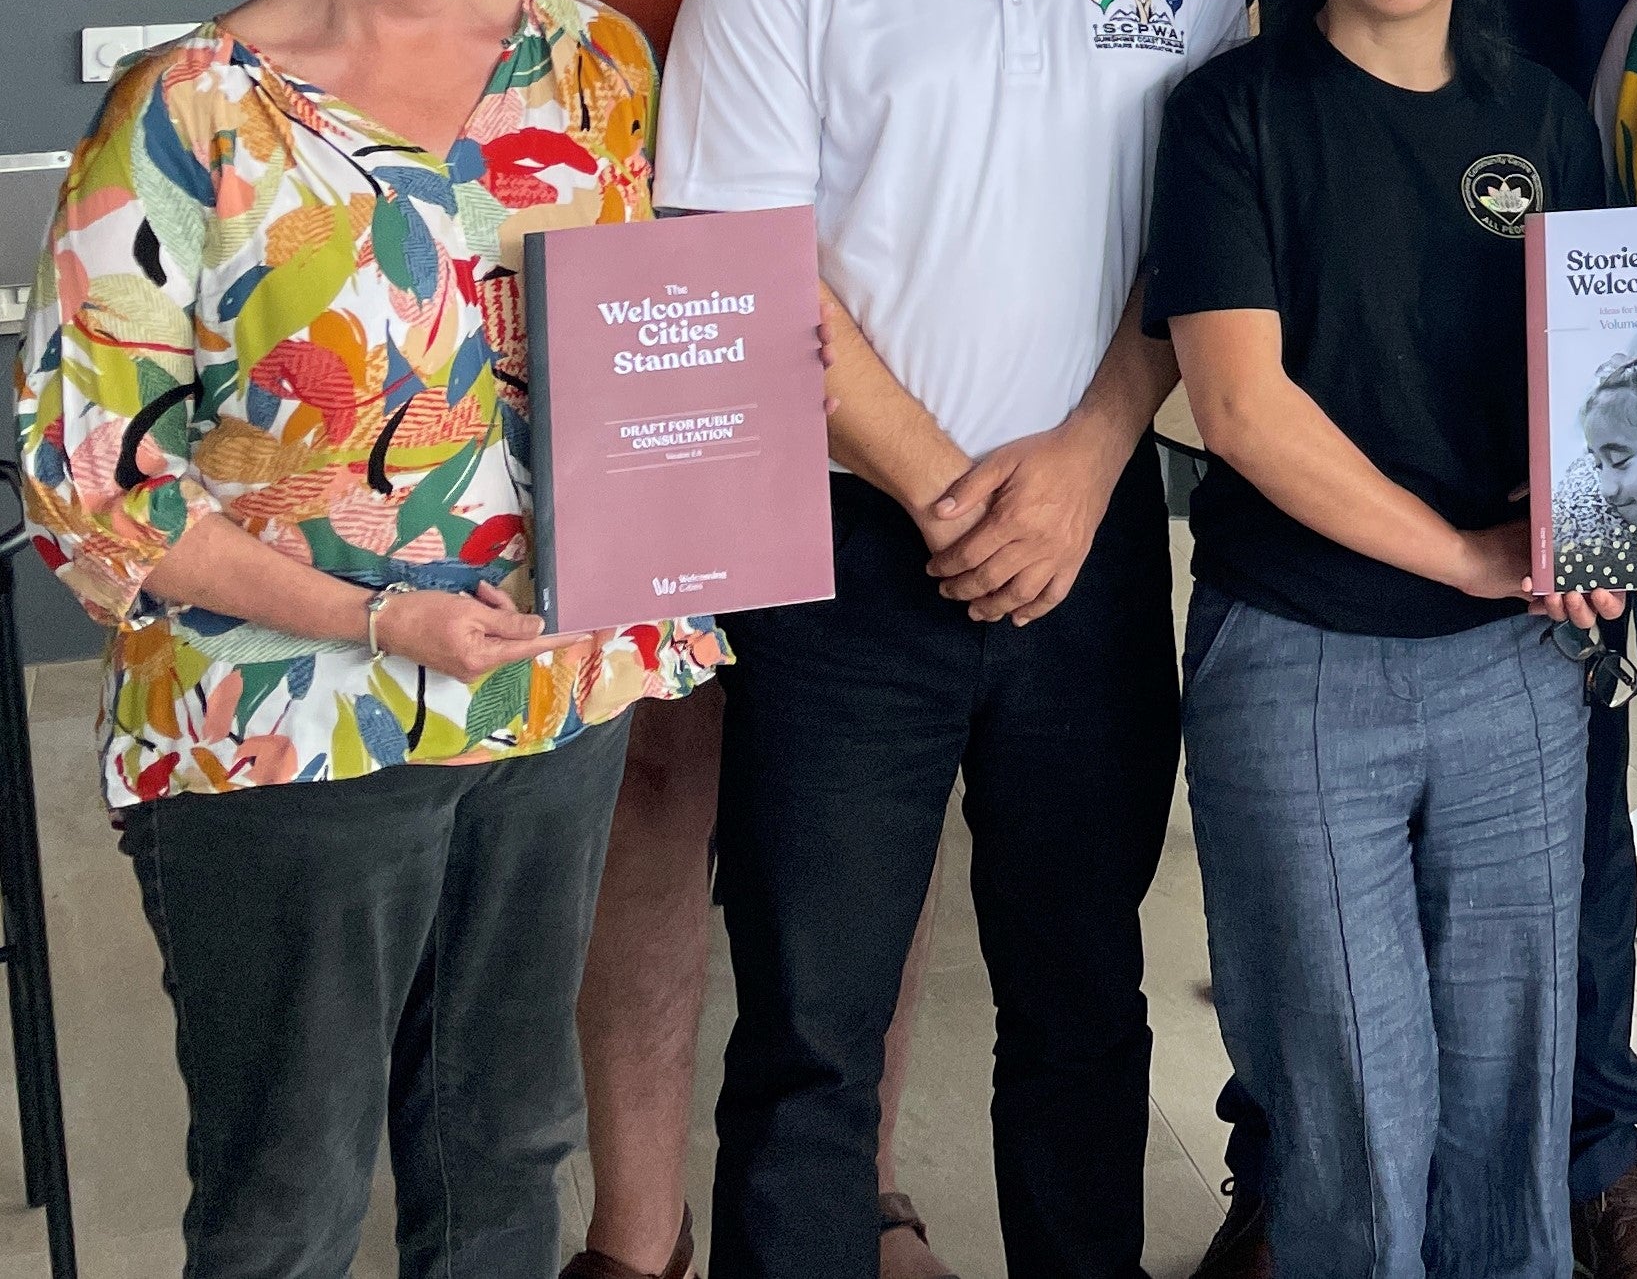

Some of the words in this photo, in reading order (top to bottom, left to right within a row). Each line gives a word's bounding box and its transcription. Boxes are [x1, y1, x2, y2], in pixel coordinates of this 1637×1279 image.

[1481, 216, 1500, 231] ALL
[663, 283, 689, 296] The
[597, 290, 755, 325] Welcoming
[1621, 305, 1633, 315] for
[638, 319, 719, 347] Cities
[613, 337, 746, 374] Standard
[620, 422, 666, 438] DRAFT
[668, 419, 695, 432] FOR
[697, 413, 745, 429] PUBLIC
[632, 426, 734, 449] CONSULTATION
